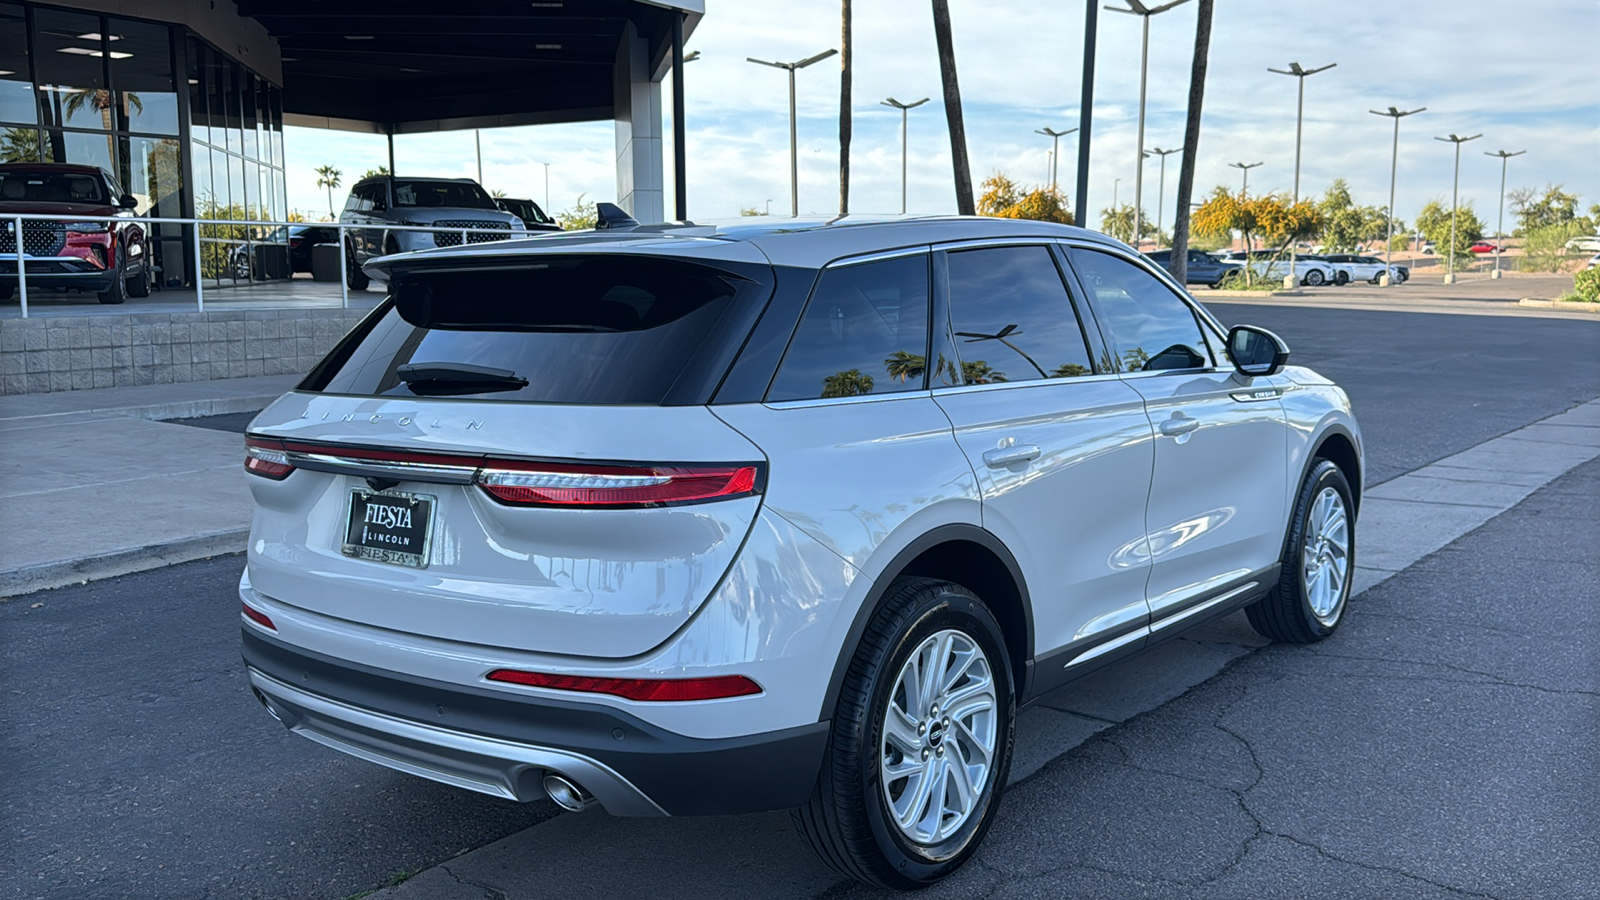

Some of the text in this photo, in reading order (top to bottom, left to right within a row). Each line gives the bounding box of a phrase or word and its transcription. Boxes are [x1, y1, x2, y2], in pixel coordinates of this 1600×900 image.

[301, 411, 485, 430] LINCOLN
[364, 503, 412, 528] FIESTA
[368, 532, 410, 545] LINCOLN
